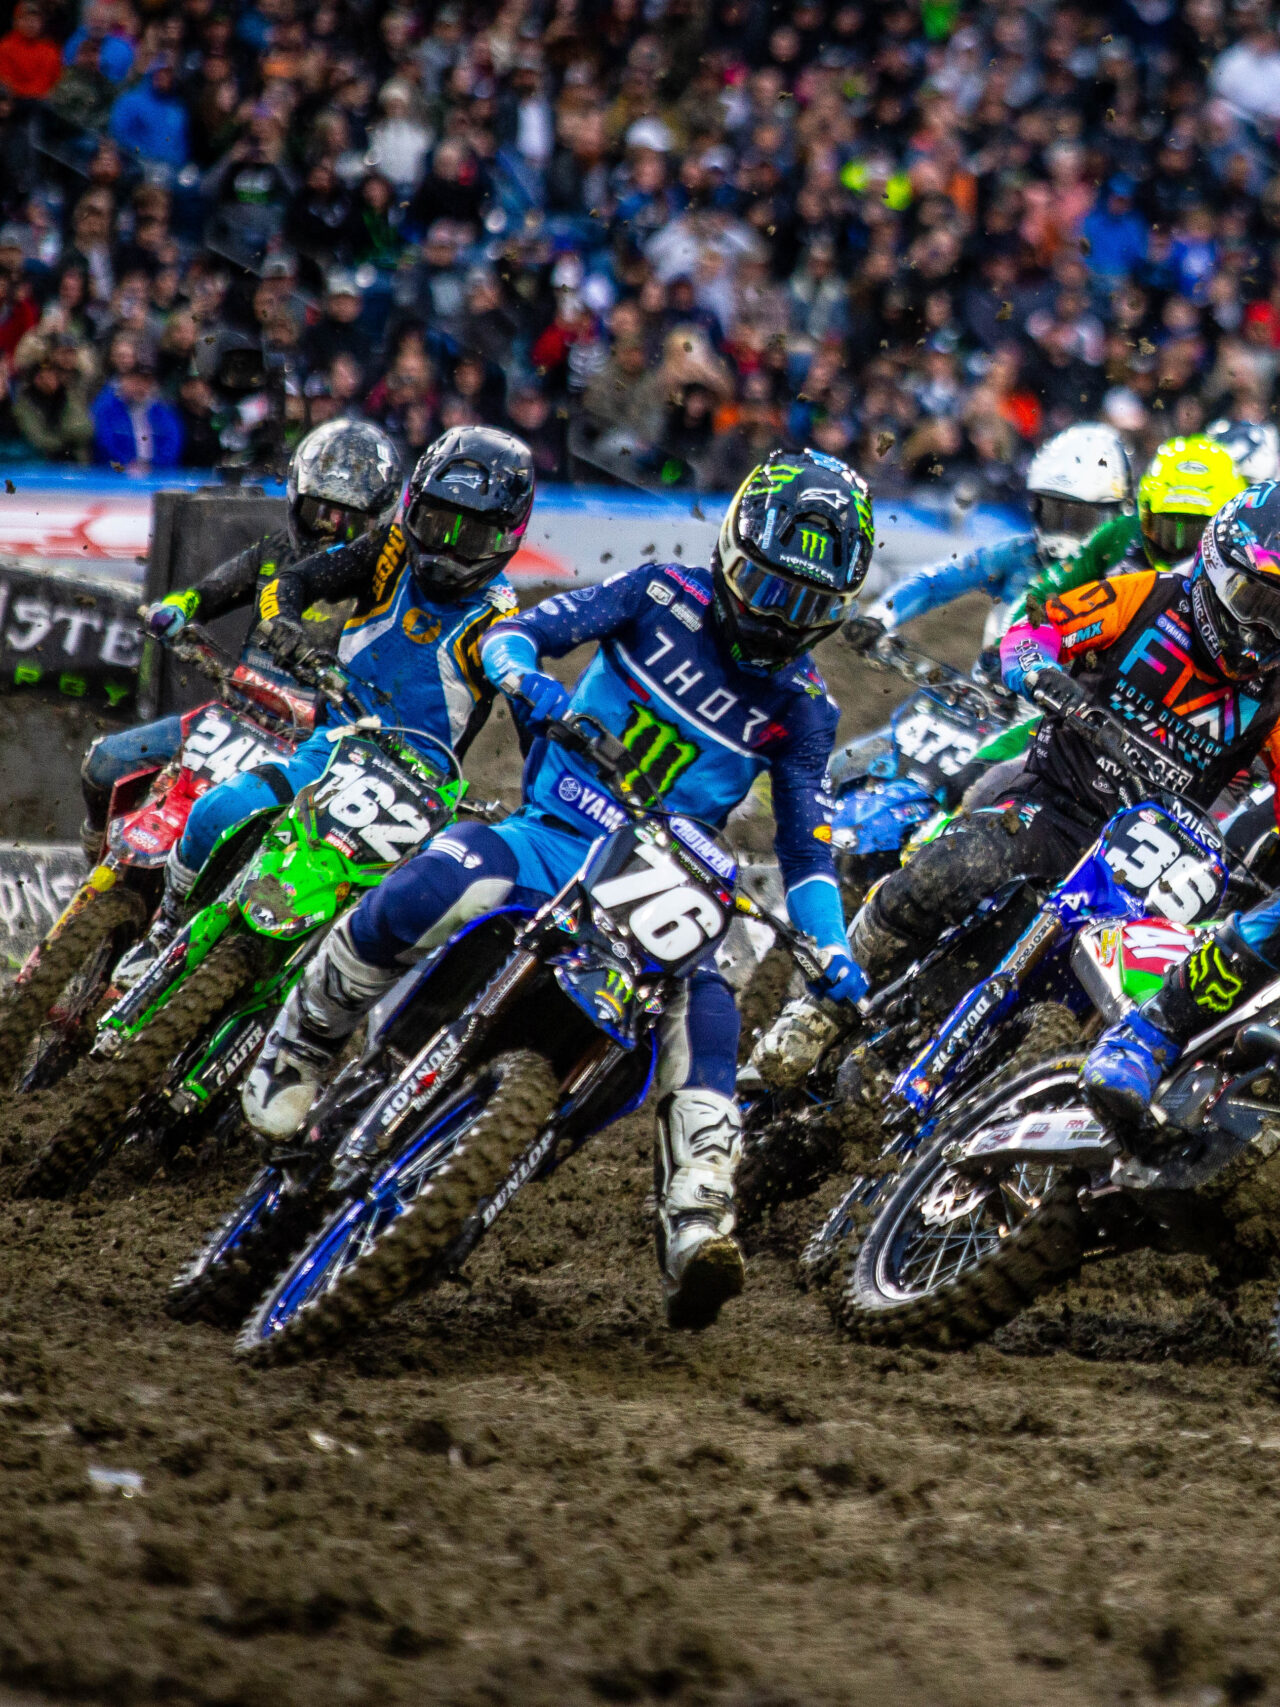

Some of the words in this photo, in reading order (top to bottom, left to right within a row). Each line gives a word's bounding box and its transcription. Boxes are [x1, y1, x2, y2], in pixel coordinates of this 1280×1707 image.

[779, 554, 835, 583] MONSTER
[1164, 621, 1190, 649] YAMAHA
[1115, 678, 1155, 712] MOTO
[1158, 710, 1223, 758] DIVISION
[313, 761, 431, 862] 162
[671, 816, 738, 880] PROTAPER
[591, 843, 725, 961] 76
[1104, 820, 1216, 926] 36
[216, 1024, 266, 1087] CALFER
[381, 1033, 460, 1127] DUNLOP
[483, 1130, 556, 1228] DUNLOP
